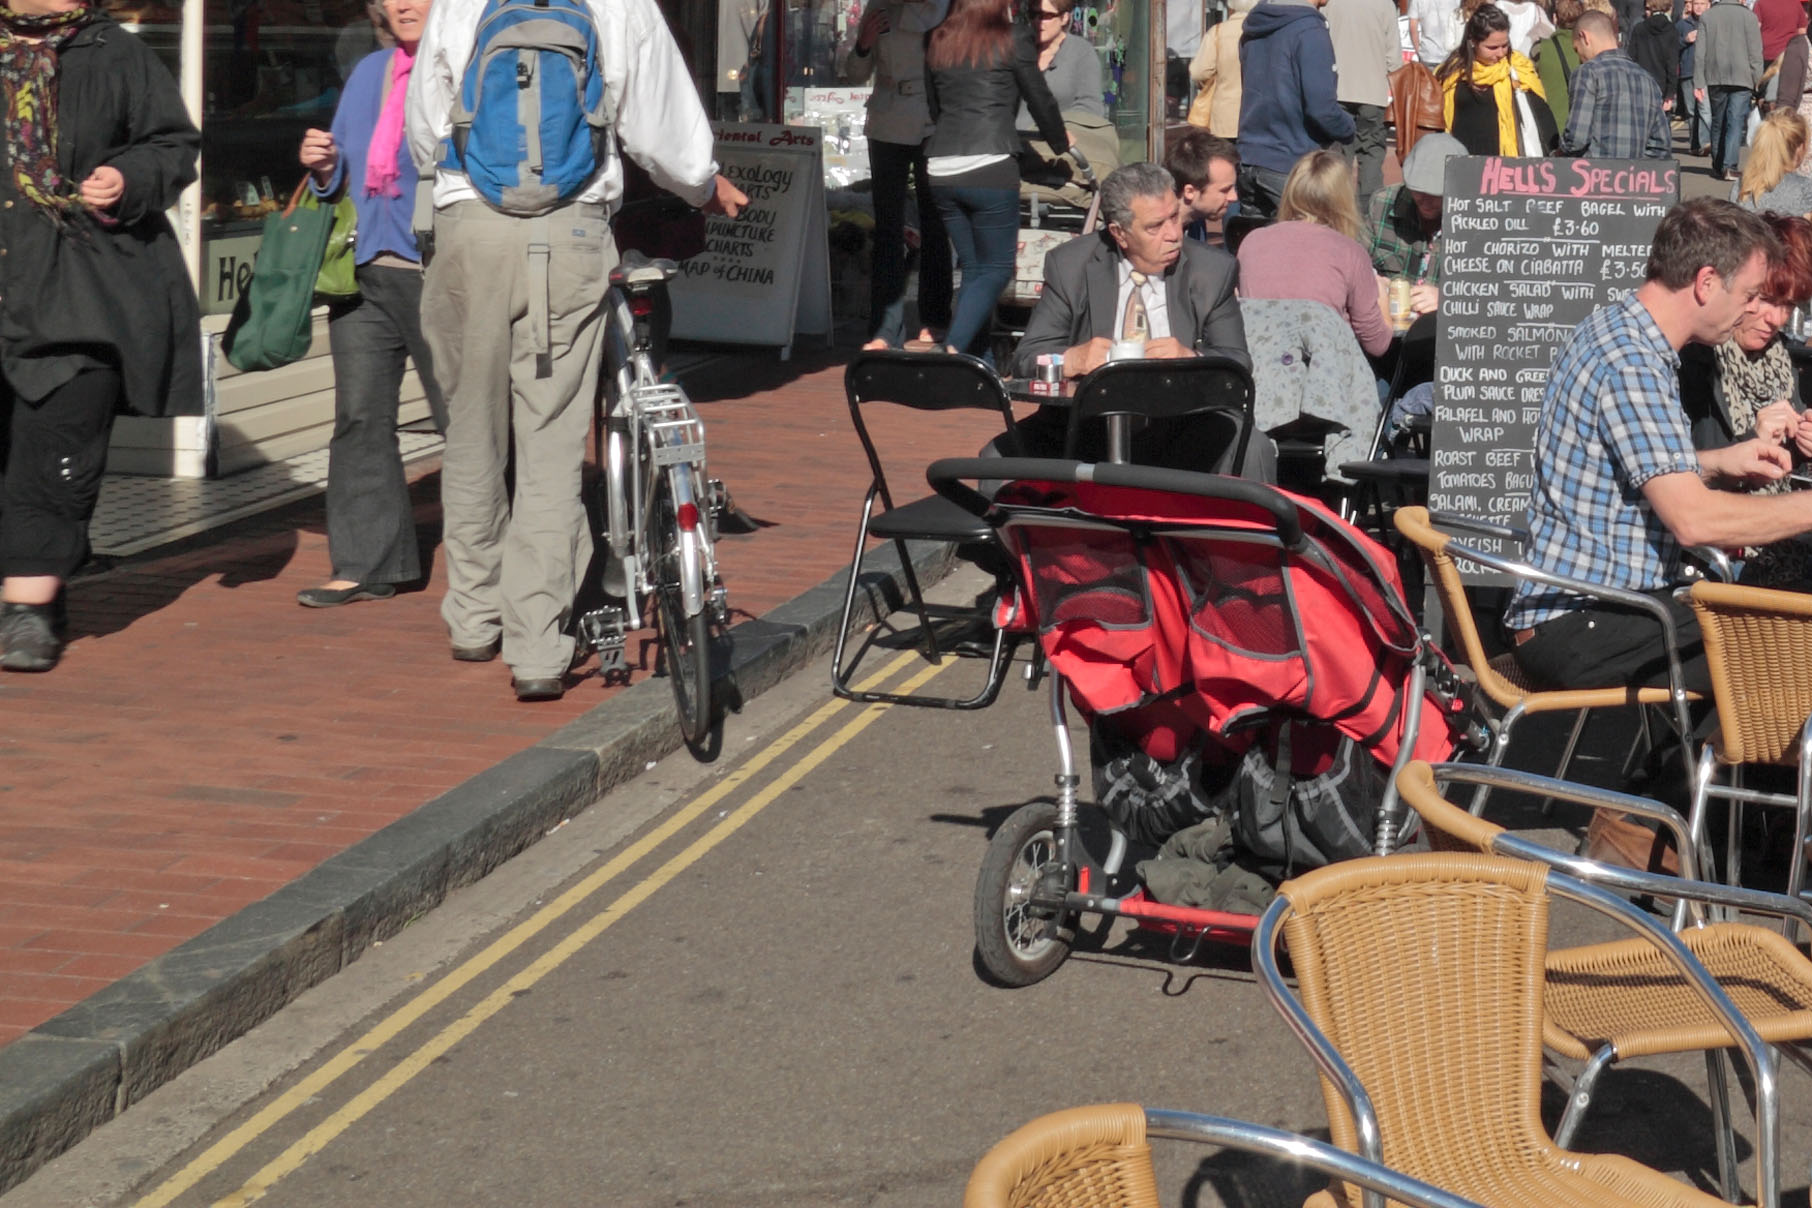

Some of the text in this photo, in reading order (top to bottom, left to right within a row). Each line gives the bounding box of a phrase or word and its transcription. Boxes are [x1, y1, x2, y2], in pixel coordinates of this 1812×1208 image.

[769, 129, 815, 146] Arts
[1447, 197, 1469, 213] HOT
[1475, 199, 1512, 213] SALT
[1525, 200, 1564, 214] BEEF
[1581, 201, 1625, 216] BAGEL
[1505, 216, 1529, 230] DILL
[1445, 240, 1466, 254] HOT
[678, 259, 710, 278] MAP
[726, 266, 774, 285] CHINA
[1444, 257, 1491, 275] CHEESE
[1496, 259, 1514, 274] ON
[218, 256, 258, 302] He
[1443, 280, 1499, 297] CHICKEN
[1509, 282, 1551, 298] SALAD
[1486, 302, 1518, 317] SAUCE
[1523, 303, 1554, 319] WRAP
[1447, 326, 1567, 342] SMOKED SALMON
[1493, 344, 1541, 360] ROCKET
[1440, 366, 1549, 383] DUCK AND GREE
[1443, 385, 1476, 401] PLUM
[1480, 386, 1516, 401] SAUCE
[1435, 405, 1489, 423] FALAFEL
[1492, 410, 1517, 424] AND
[1459, 426, 1505, 443] WRAP
[1435, 450, 1521, 467] ROAST BEEF
[1437, 471, 1496, 489] TOMATOES
